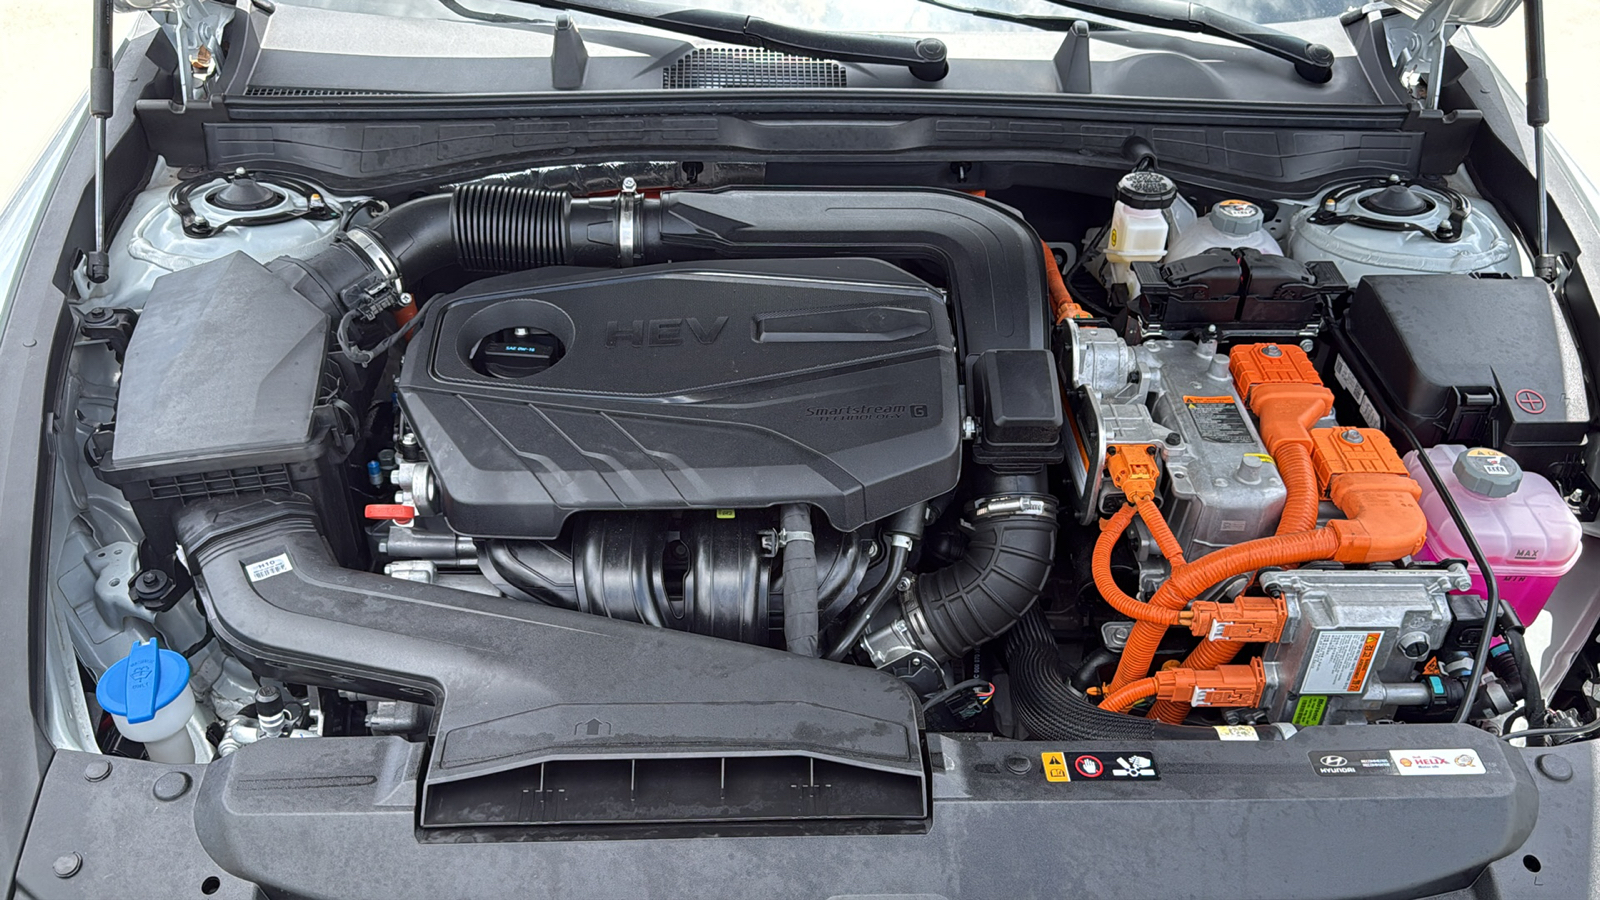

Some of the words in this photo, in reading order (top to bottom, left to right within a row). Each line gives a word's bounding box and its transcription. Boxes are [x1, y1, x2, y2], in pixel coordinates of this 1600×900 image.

[605, 316, 729, 348] HEV
[806, 405, 906, 417] Smartstream
[819, 413, 904, 421] TECHNOLOGY
[1516, 549, 1539, 557] MAX
